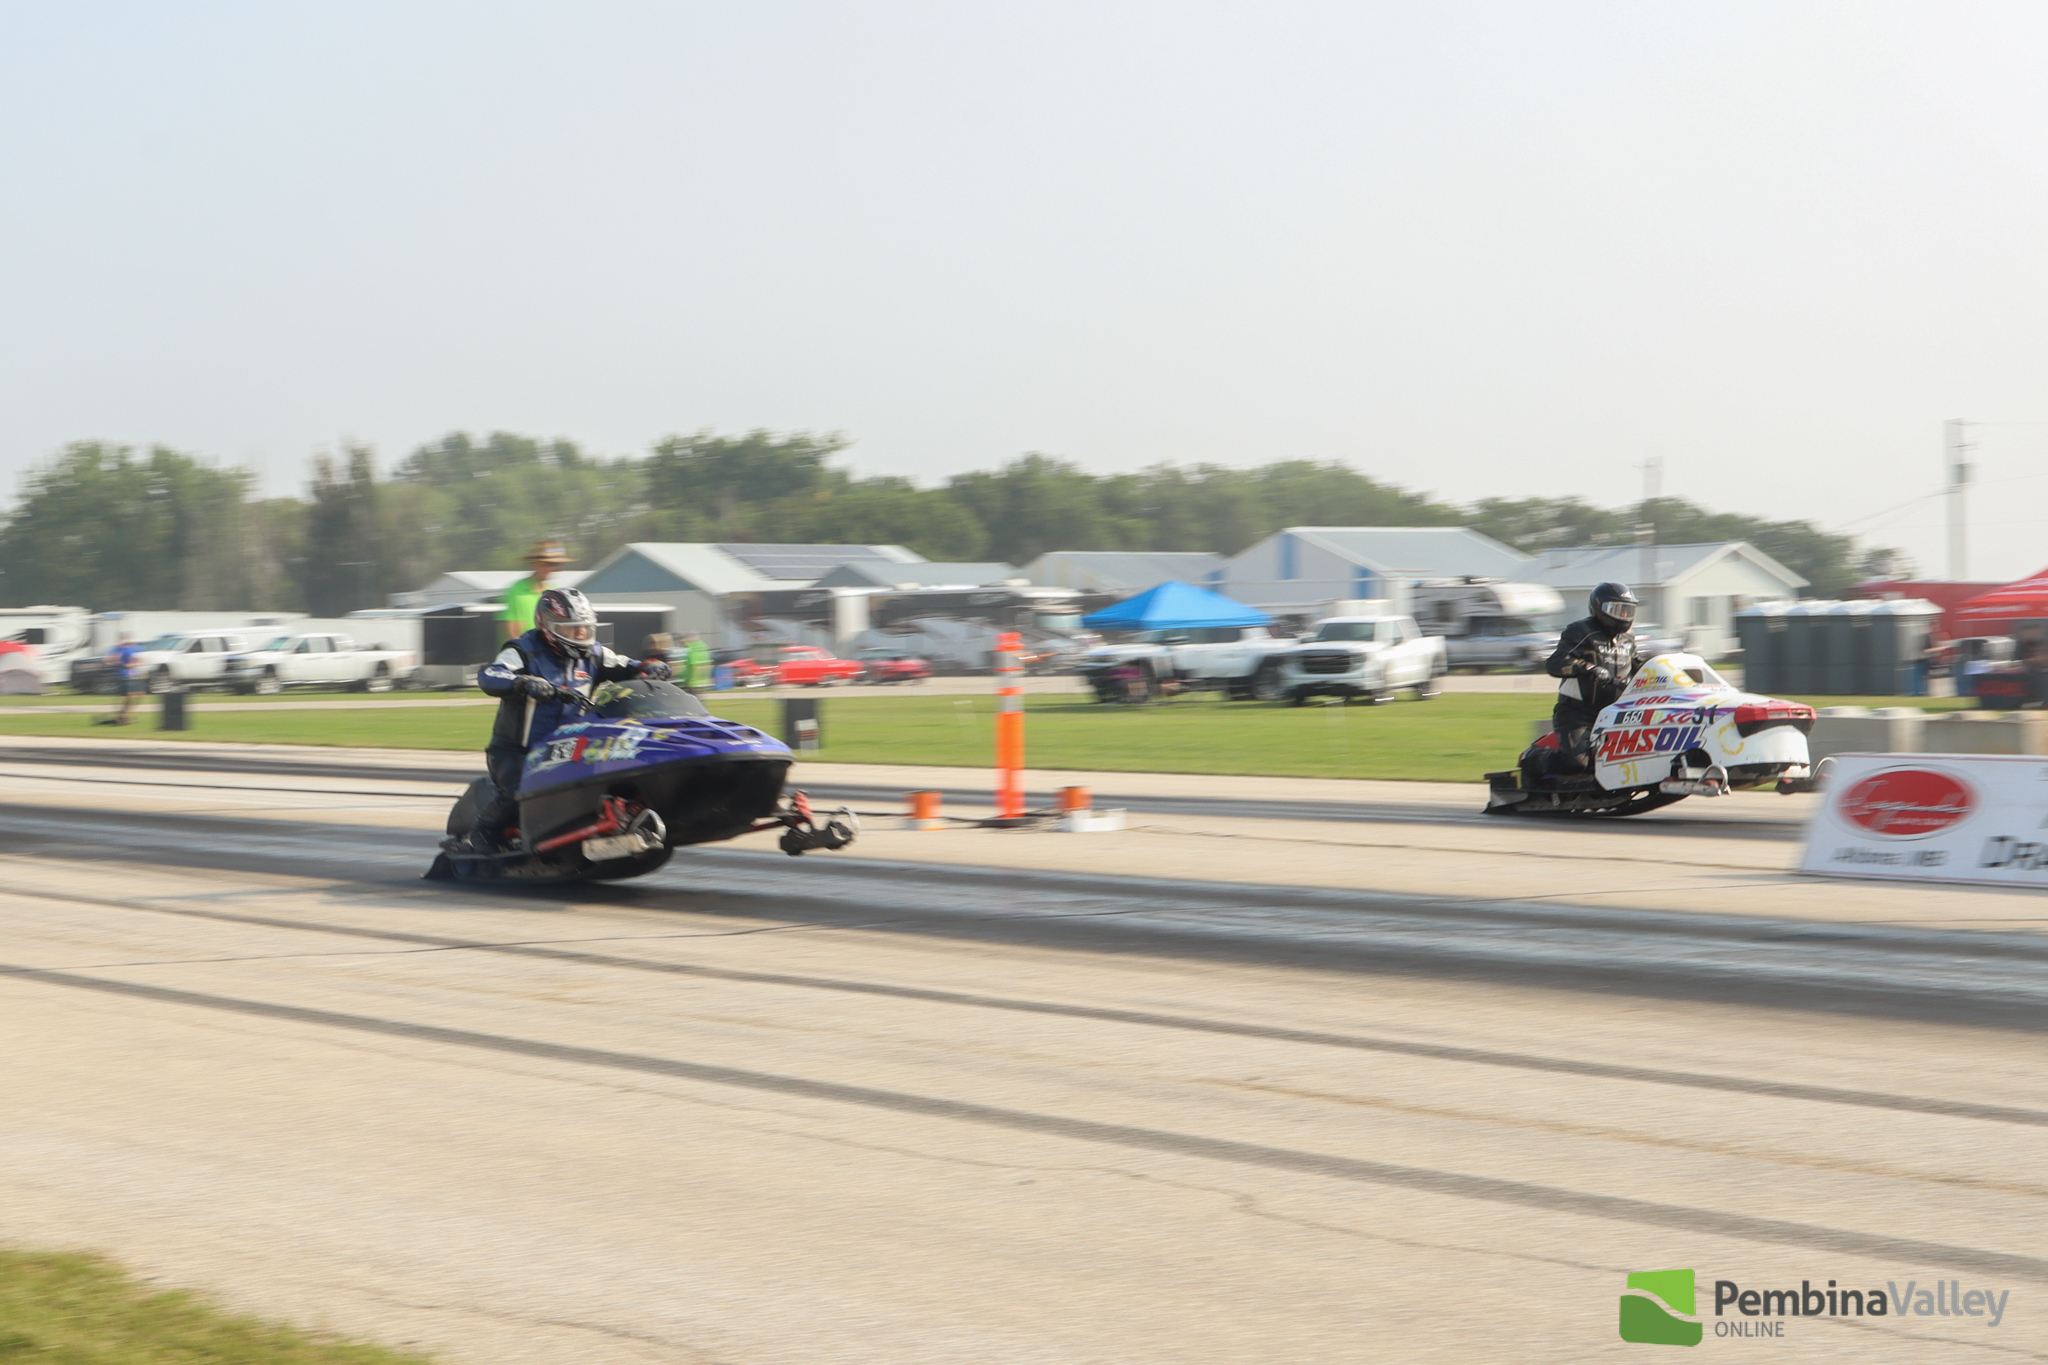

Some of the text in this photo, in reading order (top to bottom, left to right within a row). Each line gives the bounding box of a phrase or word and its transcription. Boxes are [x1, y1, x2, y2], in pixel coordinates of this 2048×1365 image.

[1634, 695, 1672, 706] 600
[1622, 711, 1644, 724] 660
[1598, 726, 1702, 763] AMSOIL
